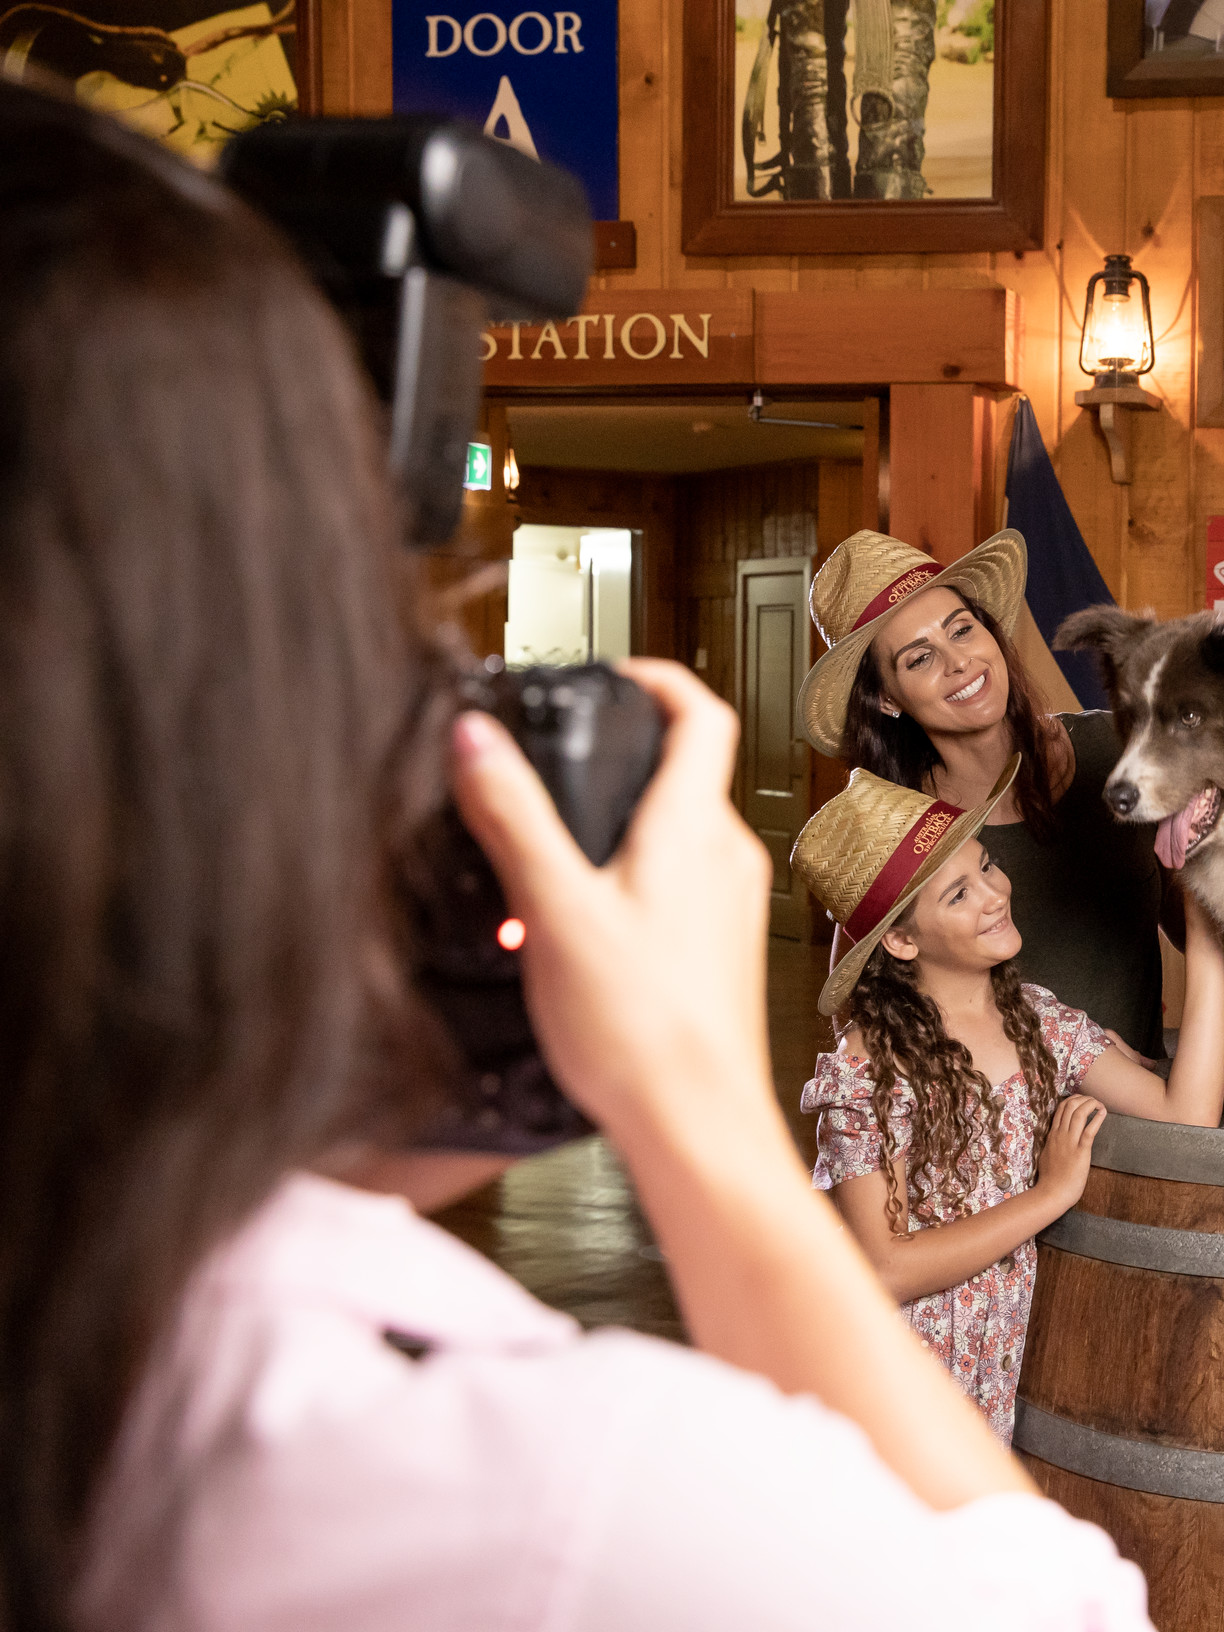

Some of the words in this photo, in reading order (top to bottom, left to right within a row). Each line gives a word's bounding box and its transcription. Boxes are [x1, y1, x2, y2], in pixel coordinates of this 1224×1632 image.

[425, 11, 585, 58] DOOR
[888, 570, 934, 603] OUTBACK
[913, 811, 950, 854] OUTBACK
